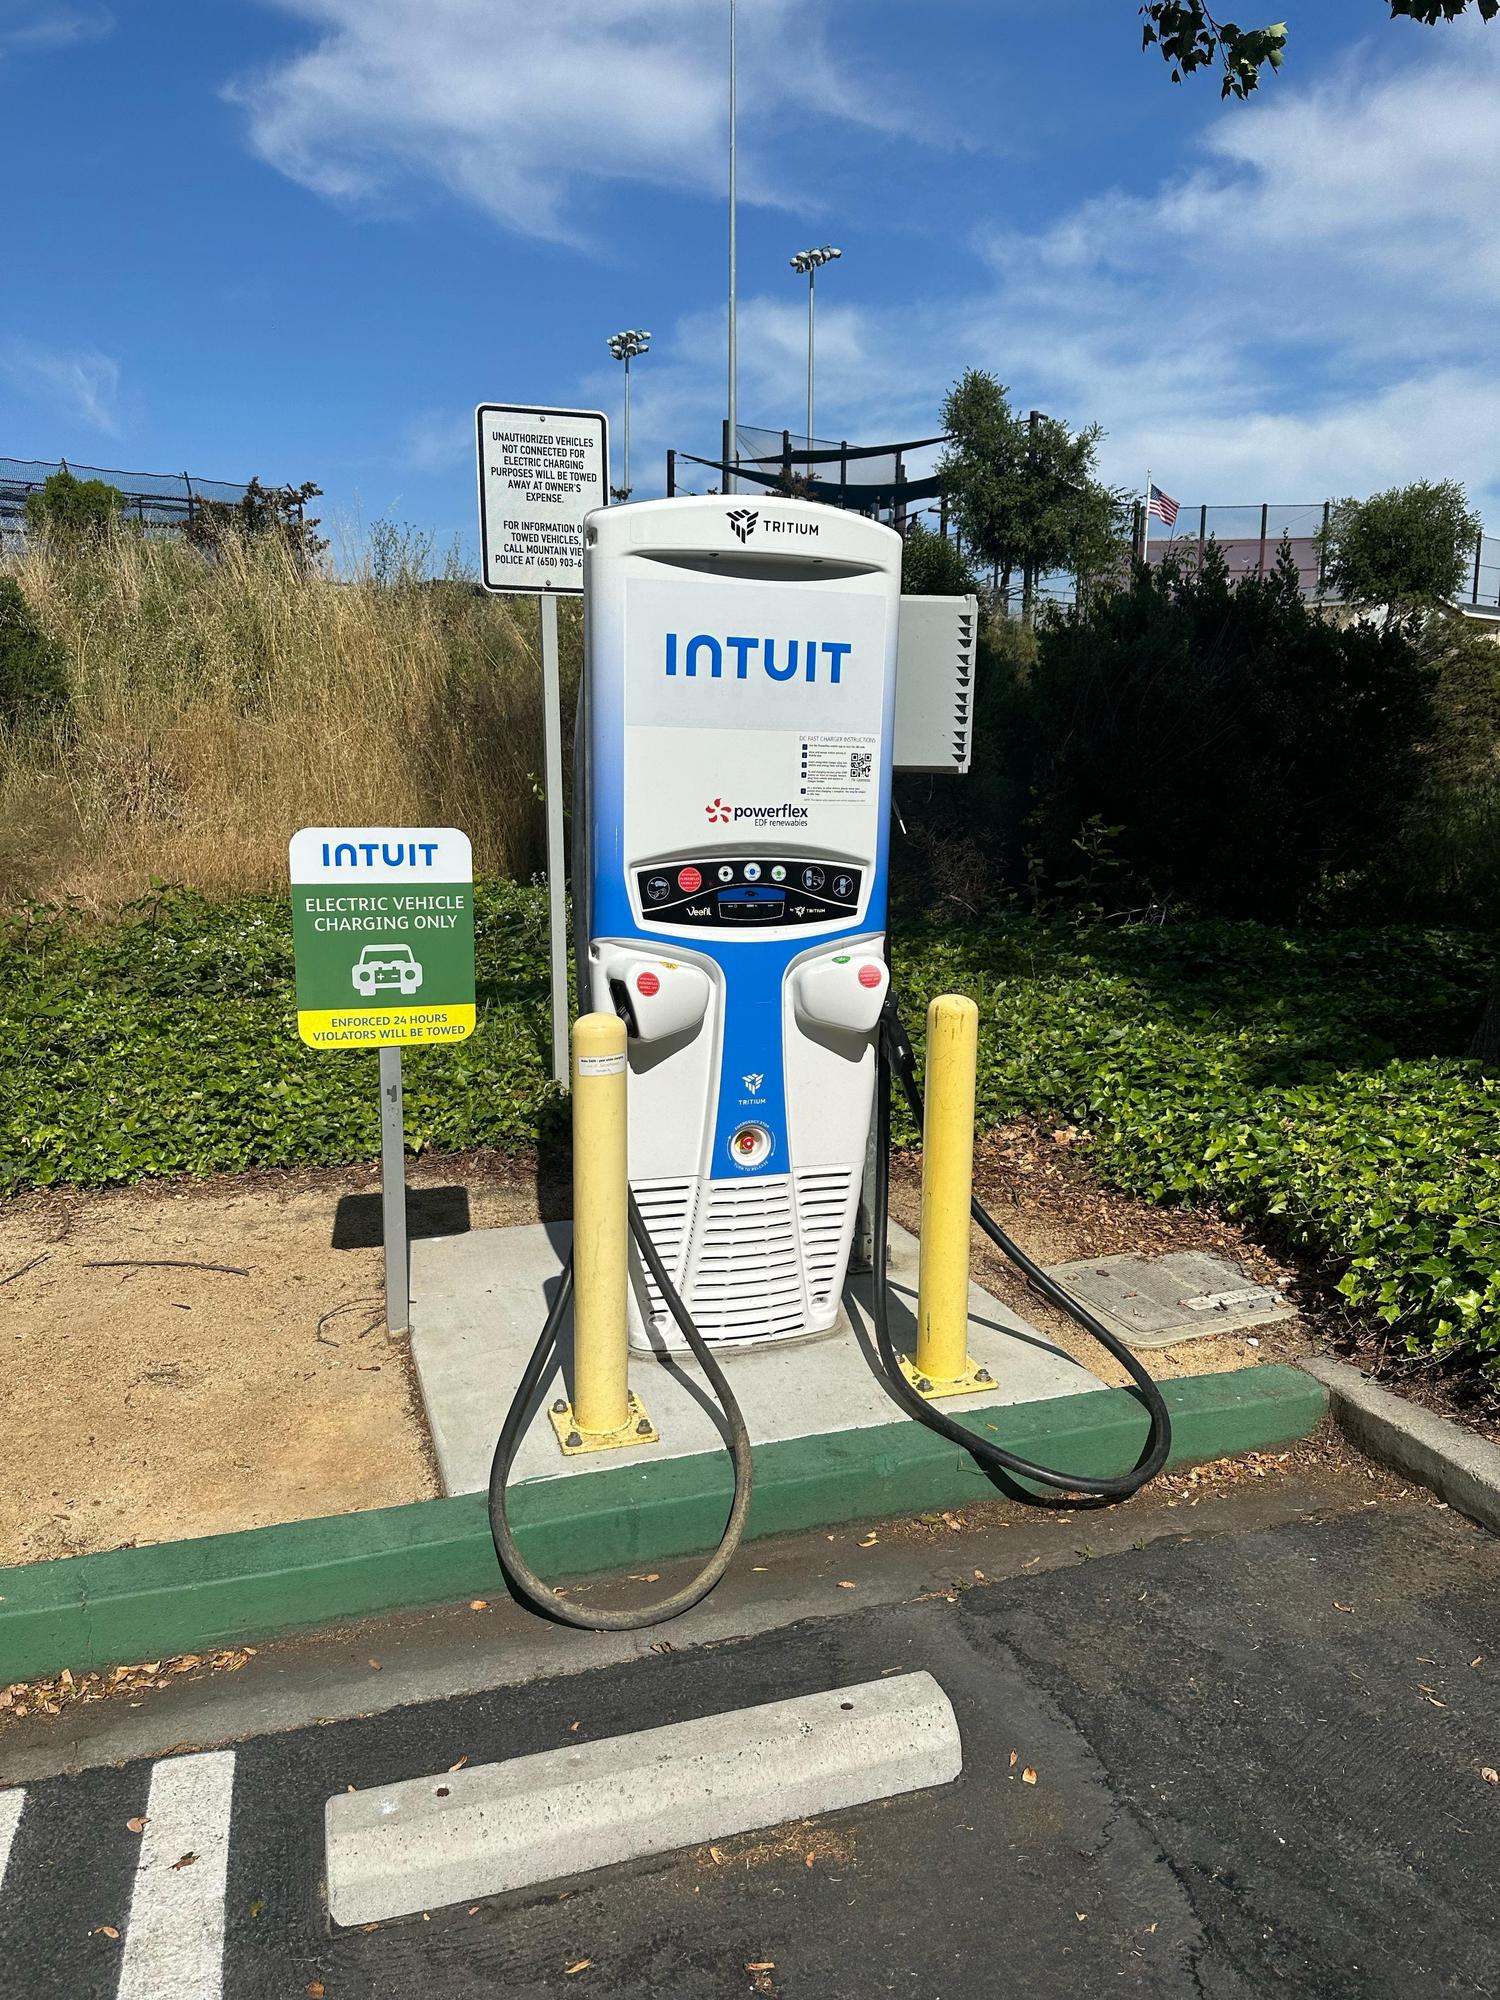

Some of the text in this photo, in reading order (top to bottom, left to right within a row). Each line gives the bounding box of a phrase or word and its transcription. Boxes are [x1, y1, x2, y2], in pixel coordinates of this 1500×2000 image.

[492, 431, 594, 448] UNAUTHORIZED VEHICLES
[502, 444, 585, 458] NOT CONNECTED FOR
[504, 456, 584, 470] ELECTRIC CHARGING
[491, 467, 597, 483] PURPOSES WILL BE TOWED
[508, 479, 582, 493] AWAY AT OWNER'S
[526, 492, 565, 503] EXPENSE.
[503, 520, 583, 533] FOR INFORMATION O
[763, 520, 819, 536] TRITIUM
[511, 532, 582, 546] TOWED VEHICLES,
[504, 544, 584, 557] CALL MOUNTAIN VIE
[495, 555, 584, 568] POLICE AT (650) 903-6
[665, 633, 852, 684] INTUIT
[734, 803, 808, 821] powerflex
[754, 818, 808, 827] EDF renewables
[322, 843, 438, 866] INTUIT
[305, 895, 465, 912] ELECTRIC VEHICLE
[686, 906, 712, 916] Veefil
[314, 914, 458, 932] CHARGING ONLY
[331, 1013, 448, 1028] ENFORCED 24 HOURS
[313, 1025, 466, 1042] VIOLATORS WILL BE TOWED
[738, 1098, 766, 1106] TRITIUM
